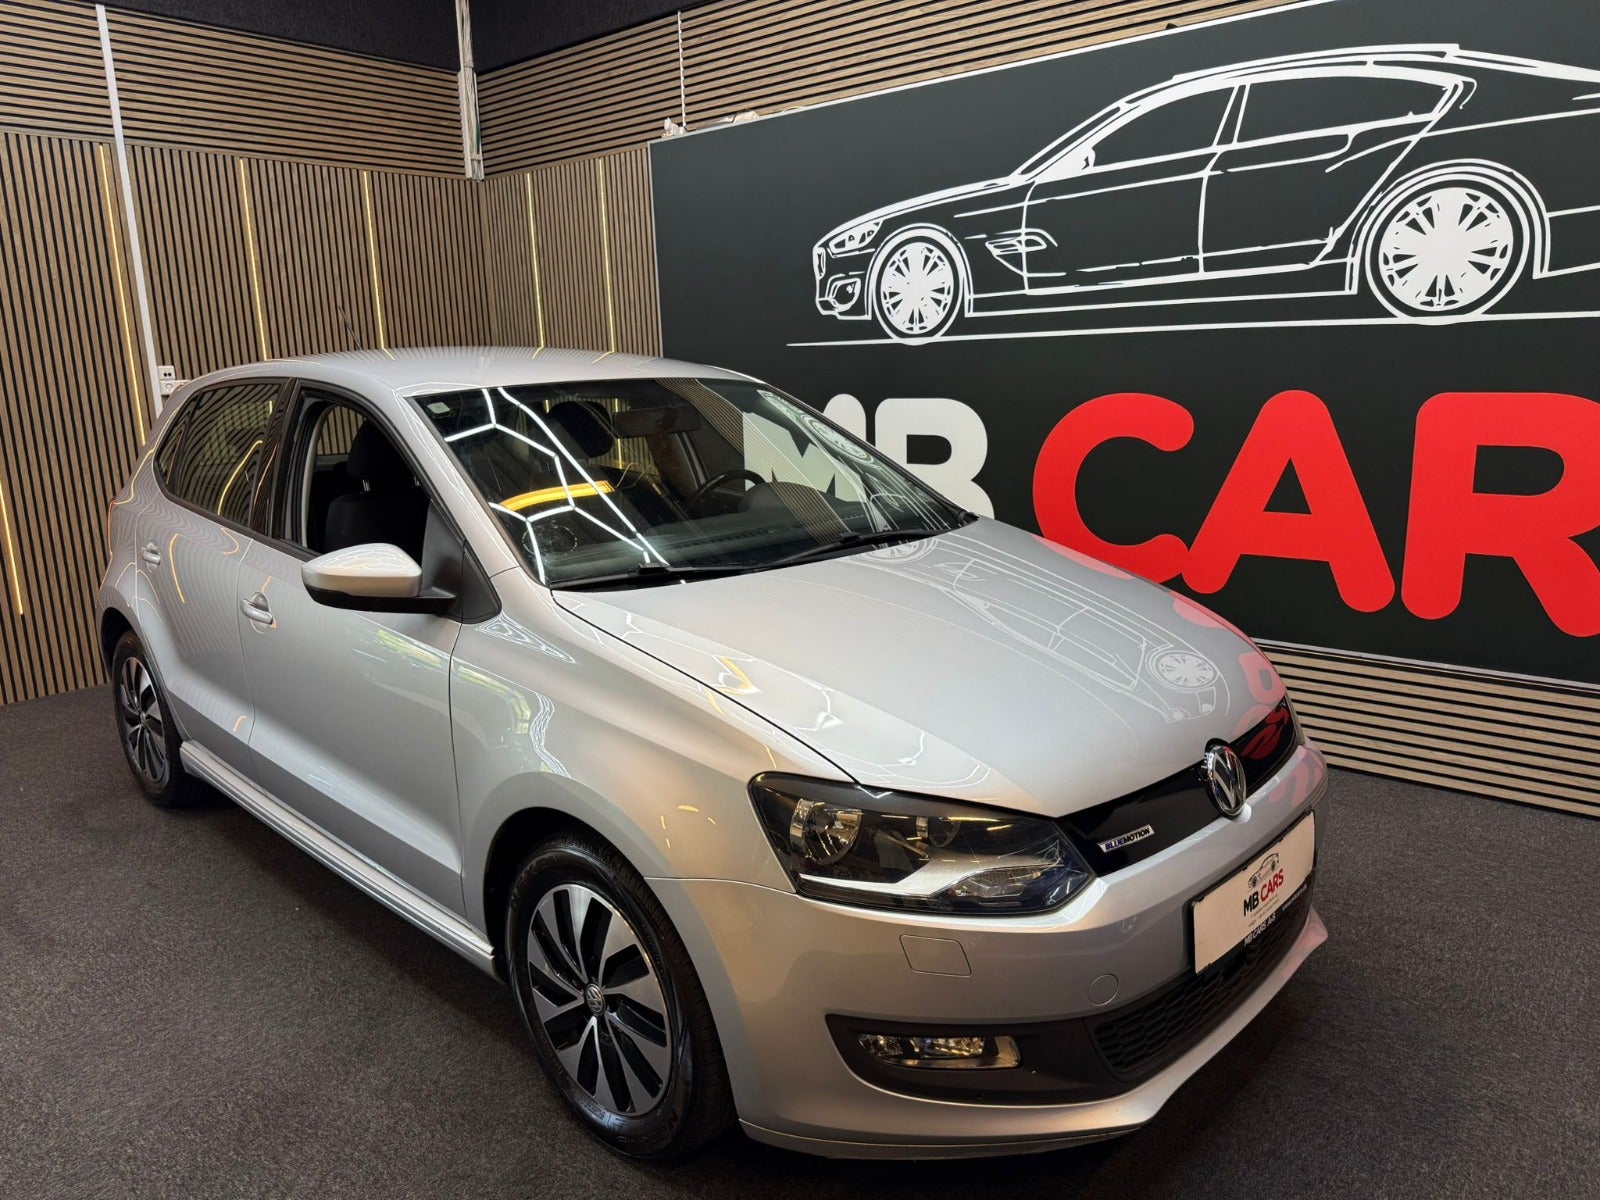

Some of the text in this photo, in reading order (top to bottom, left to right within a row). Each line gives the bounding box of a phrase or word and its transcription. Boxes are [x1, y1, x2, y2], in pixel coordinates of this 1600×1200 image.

[1104, 827, 1151, 851] BLUEMOTION
[1243, 890, 1260, 917] MB
[1260, 868, 1284, 902] CARS
